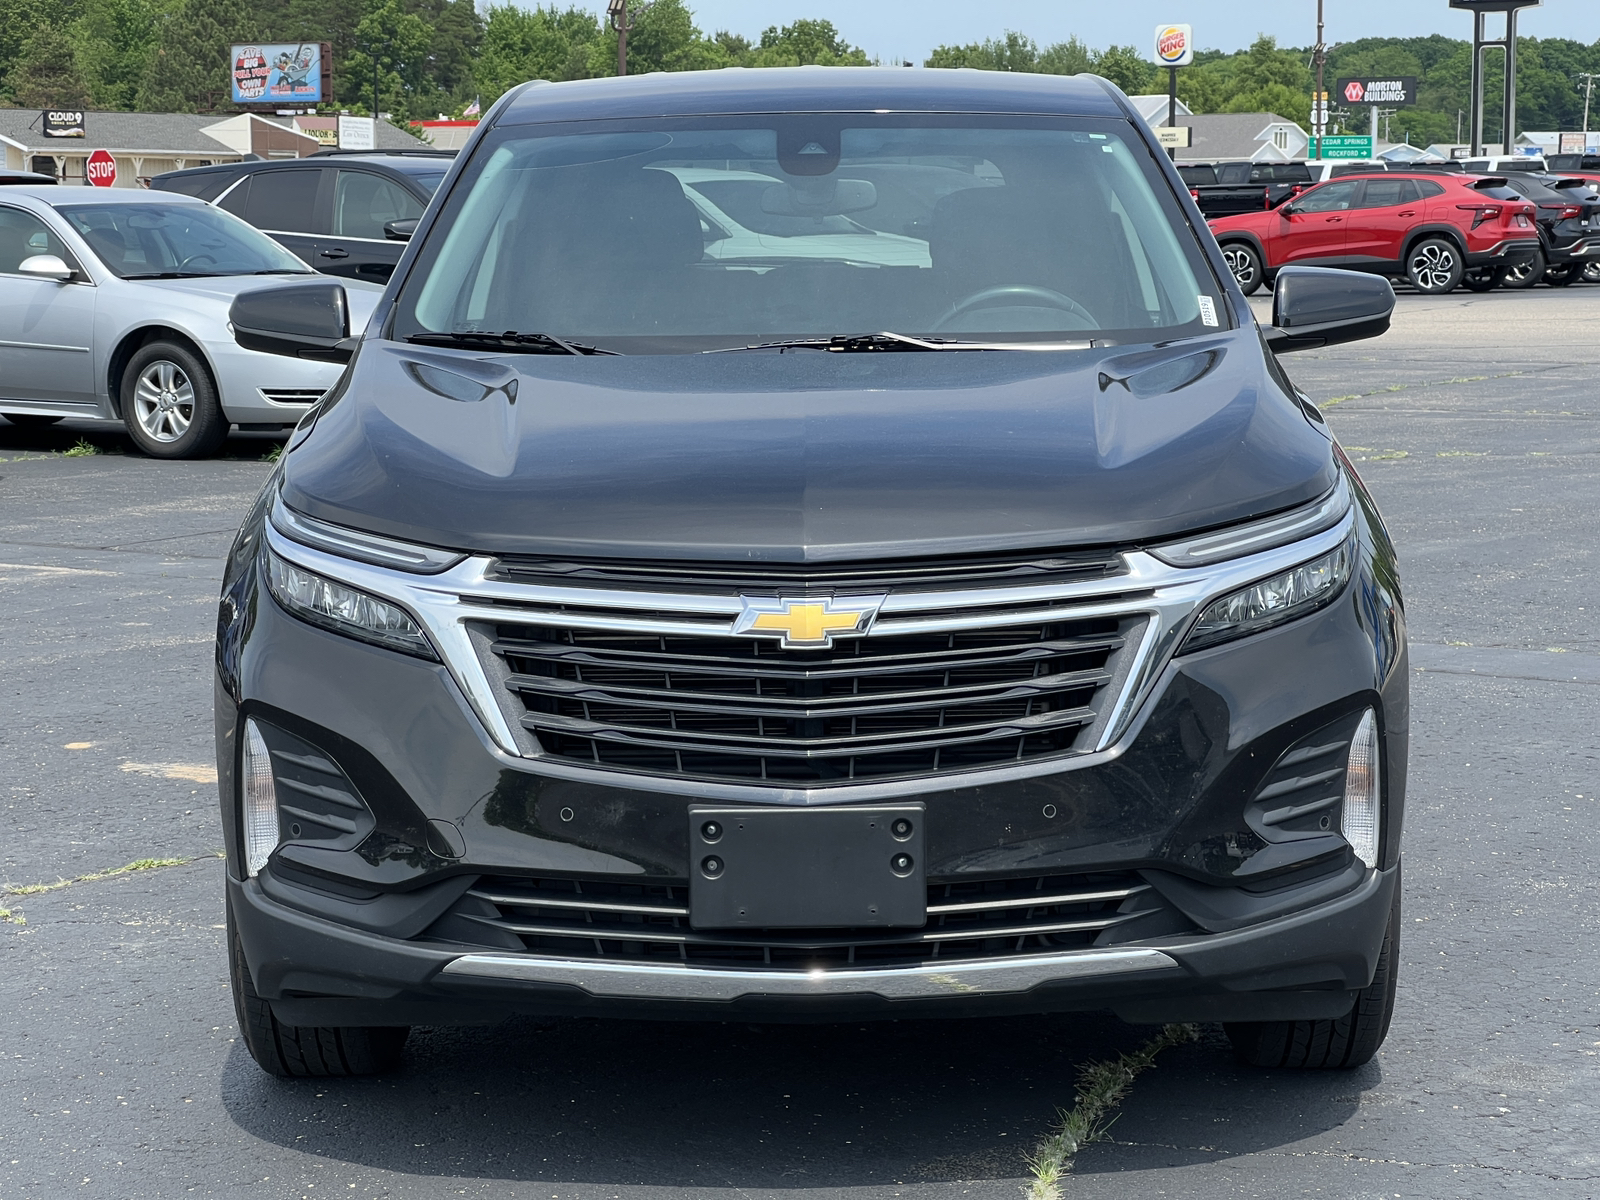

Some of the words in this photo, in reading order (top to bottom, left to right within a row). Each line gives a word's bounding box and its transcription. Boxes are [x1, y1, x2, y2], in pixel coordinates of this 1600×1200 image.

[1160, 32, 1184, 46] BURGER
[1160, 38, 1185, 55] KING
[239, 49, 262, 59] SAVE
[243, 58, 258, 68] BIG
[234, 69, 251, 78] PULL
[251, 67, 271, 77] YOUR
[241, 78, 262, 89] OWN
[1367, 81, 1402, 92] MORTON
[239, 87, 265, 98] PARTS
[1364, 91, 1406, 102] BUILDINGS
[48, 112, 74, 121] CLOUD
[75, 112, 82, 124] 9
[305, 129, 329, 139] LIQUOR
[89, 162, 114, 178] STOP
